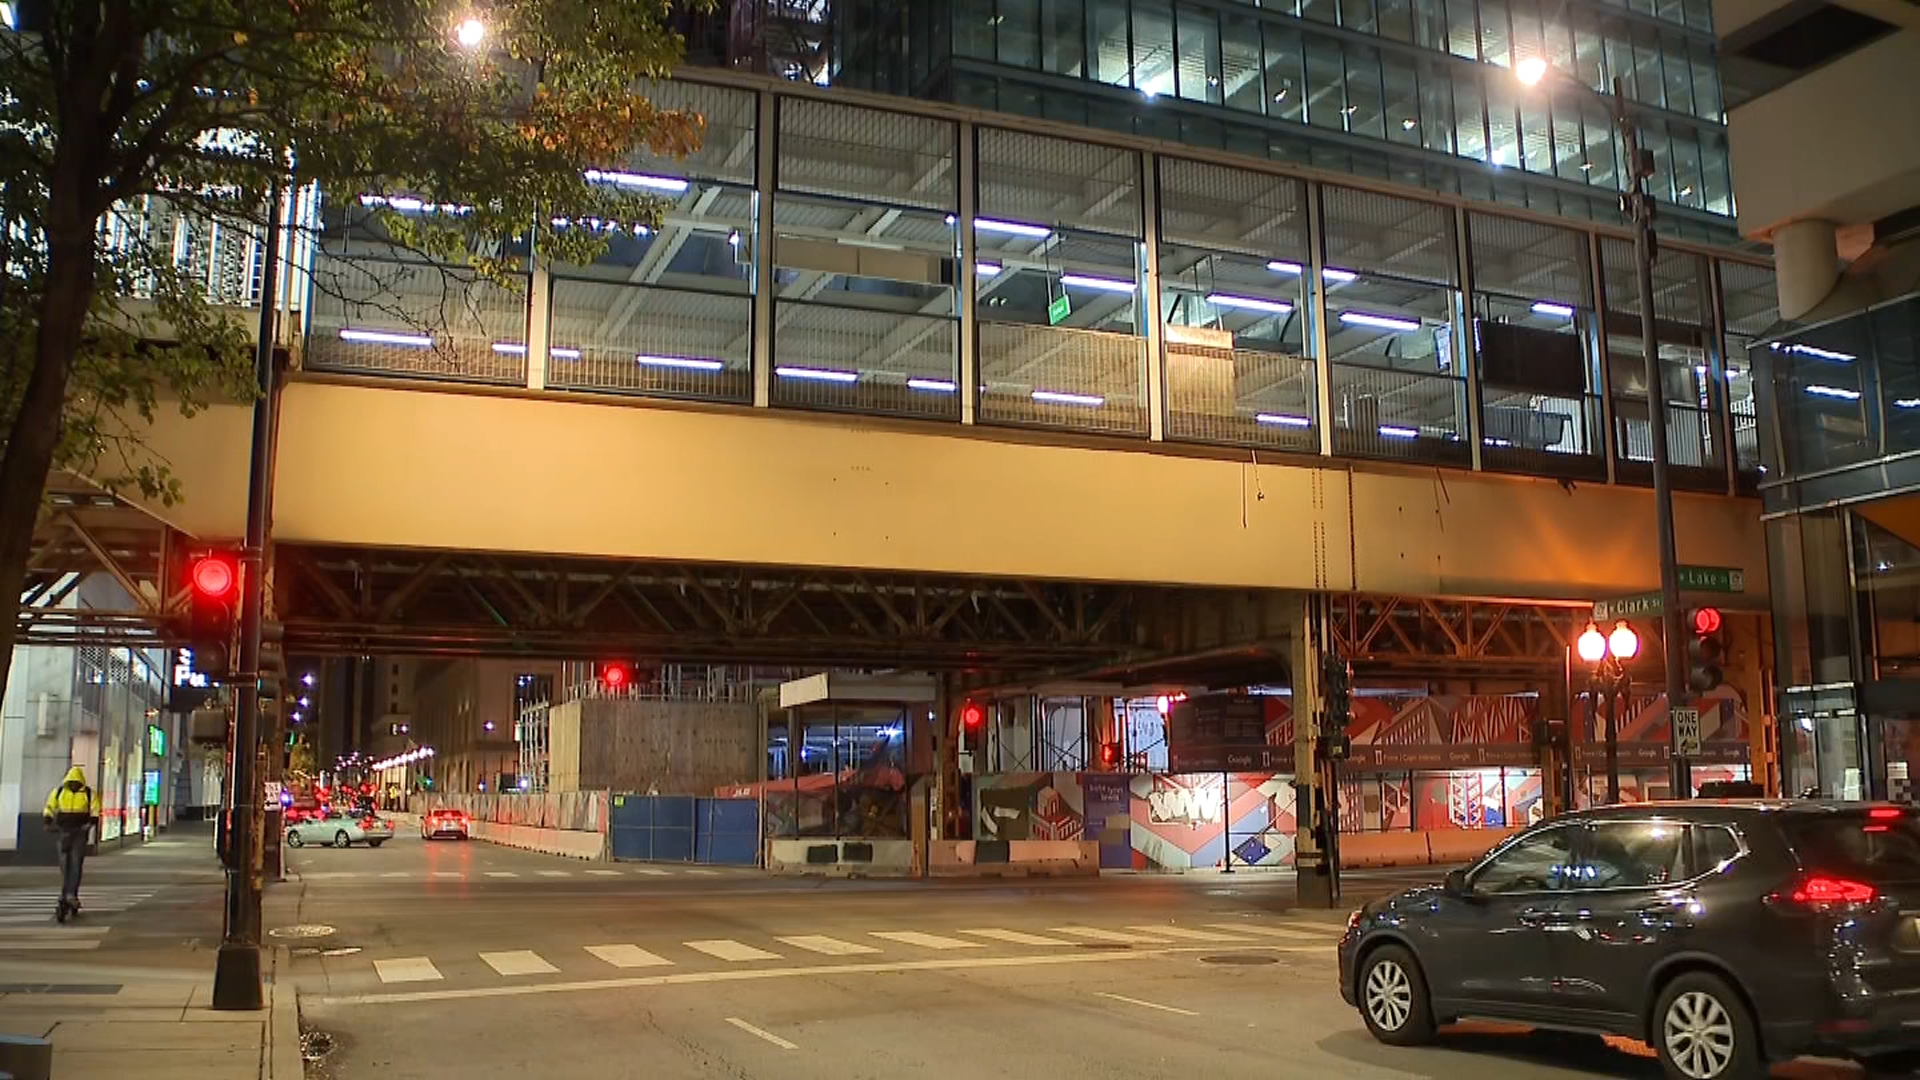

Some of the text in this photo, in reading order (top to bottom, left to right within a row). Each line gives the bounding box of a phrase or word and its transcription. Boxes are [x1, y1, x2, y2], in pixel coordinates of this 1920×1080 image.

[1688, 570, 1717, 586] Lake
[1616, 597, 1650, 614] Clark
[1676, 711, 1697, 723] ONE
[1678, 725, 1698, 738] WAY
[1227, 754, 1252, 766] Google
